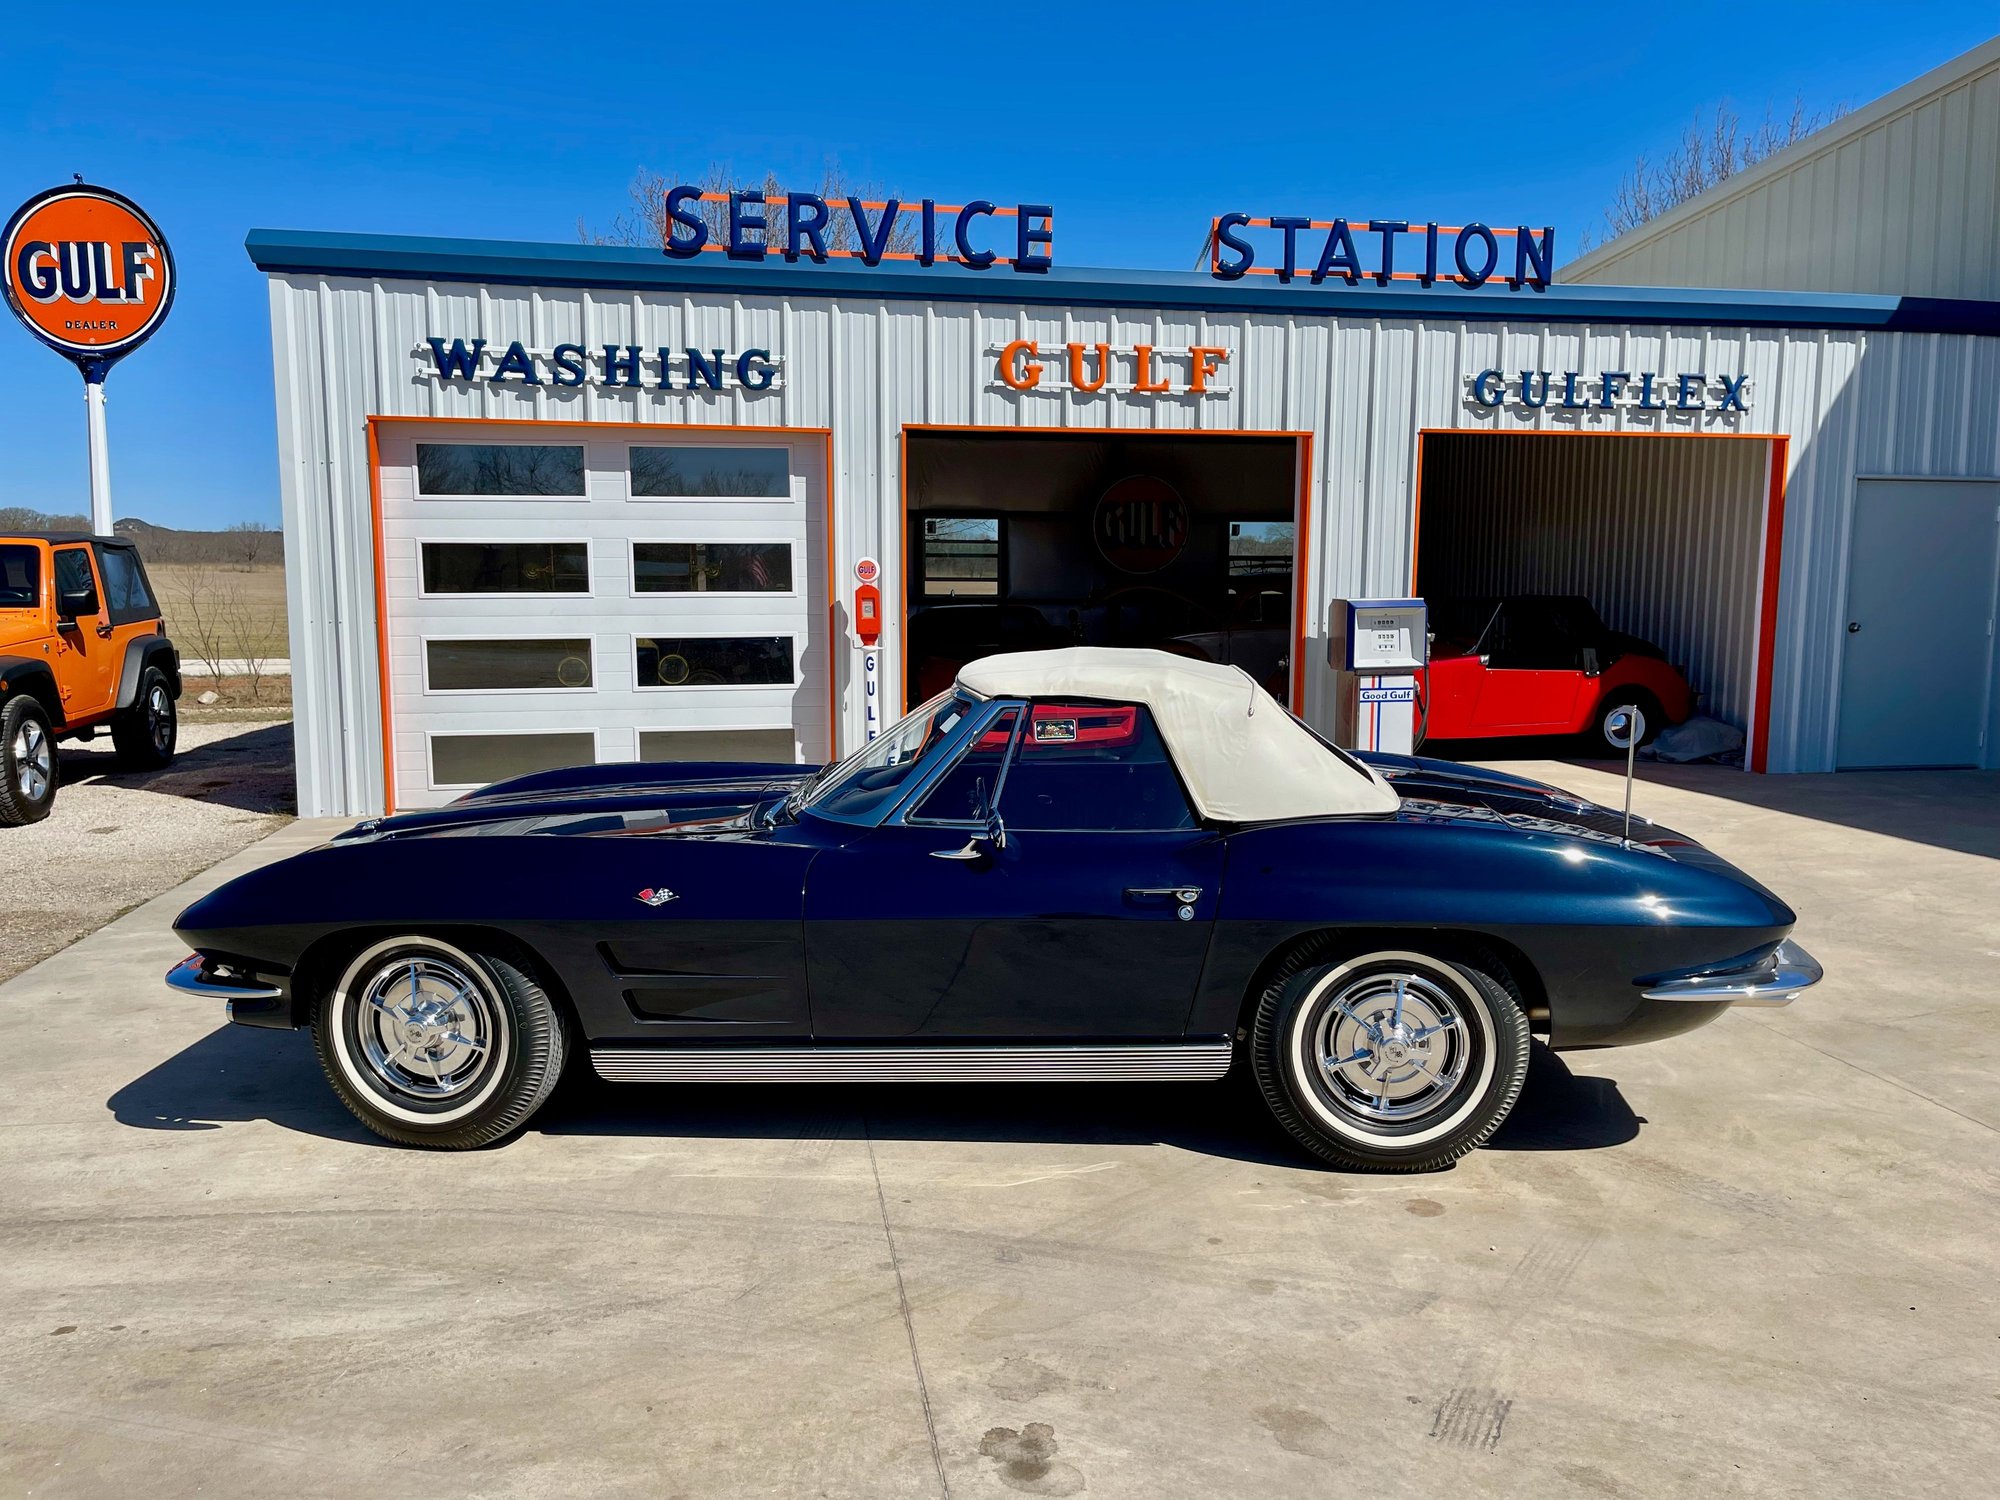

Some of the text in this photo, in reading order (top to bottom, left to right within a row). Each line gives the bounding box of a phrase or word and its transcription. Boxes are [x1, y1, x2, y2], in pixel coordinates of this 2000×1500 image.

[665, 185, 1555, 286] SERVICE STATION
[18, 240, 156, 305] GULF
[65, 320, 119, 330] DEALER
[426, 336, 776, 391] WASHING
[1000, 339, 1227, 393] GULF
[1474, 368, 1749, 412] GULFLEX
[1102, 501, 1184, 549] GULF
[858, 565, 875, 574] GULF
[1362, 690, 1412, 700] Good Gulf
